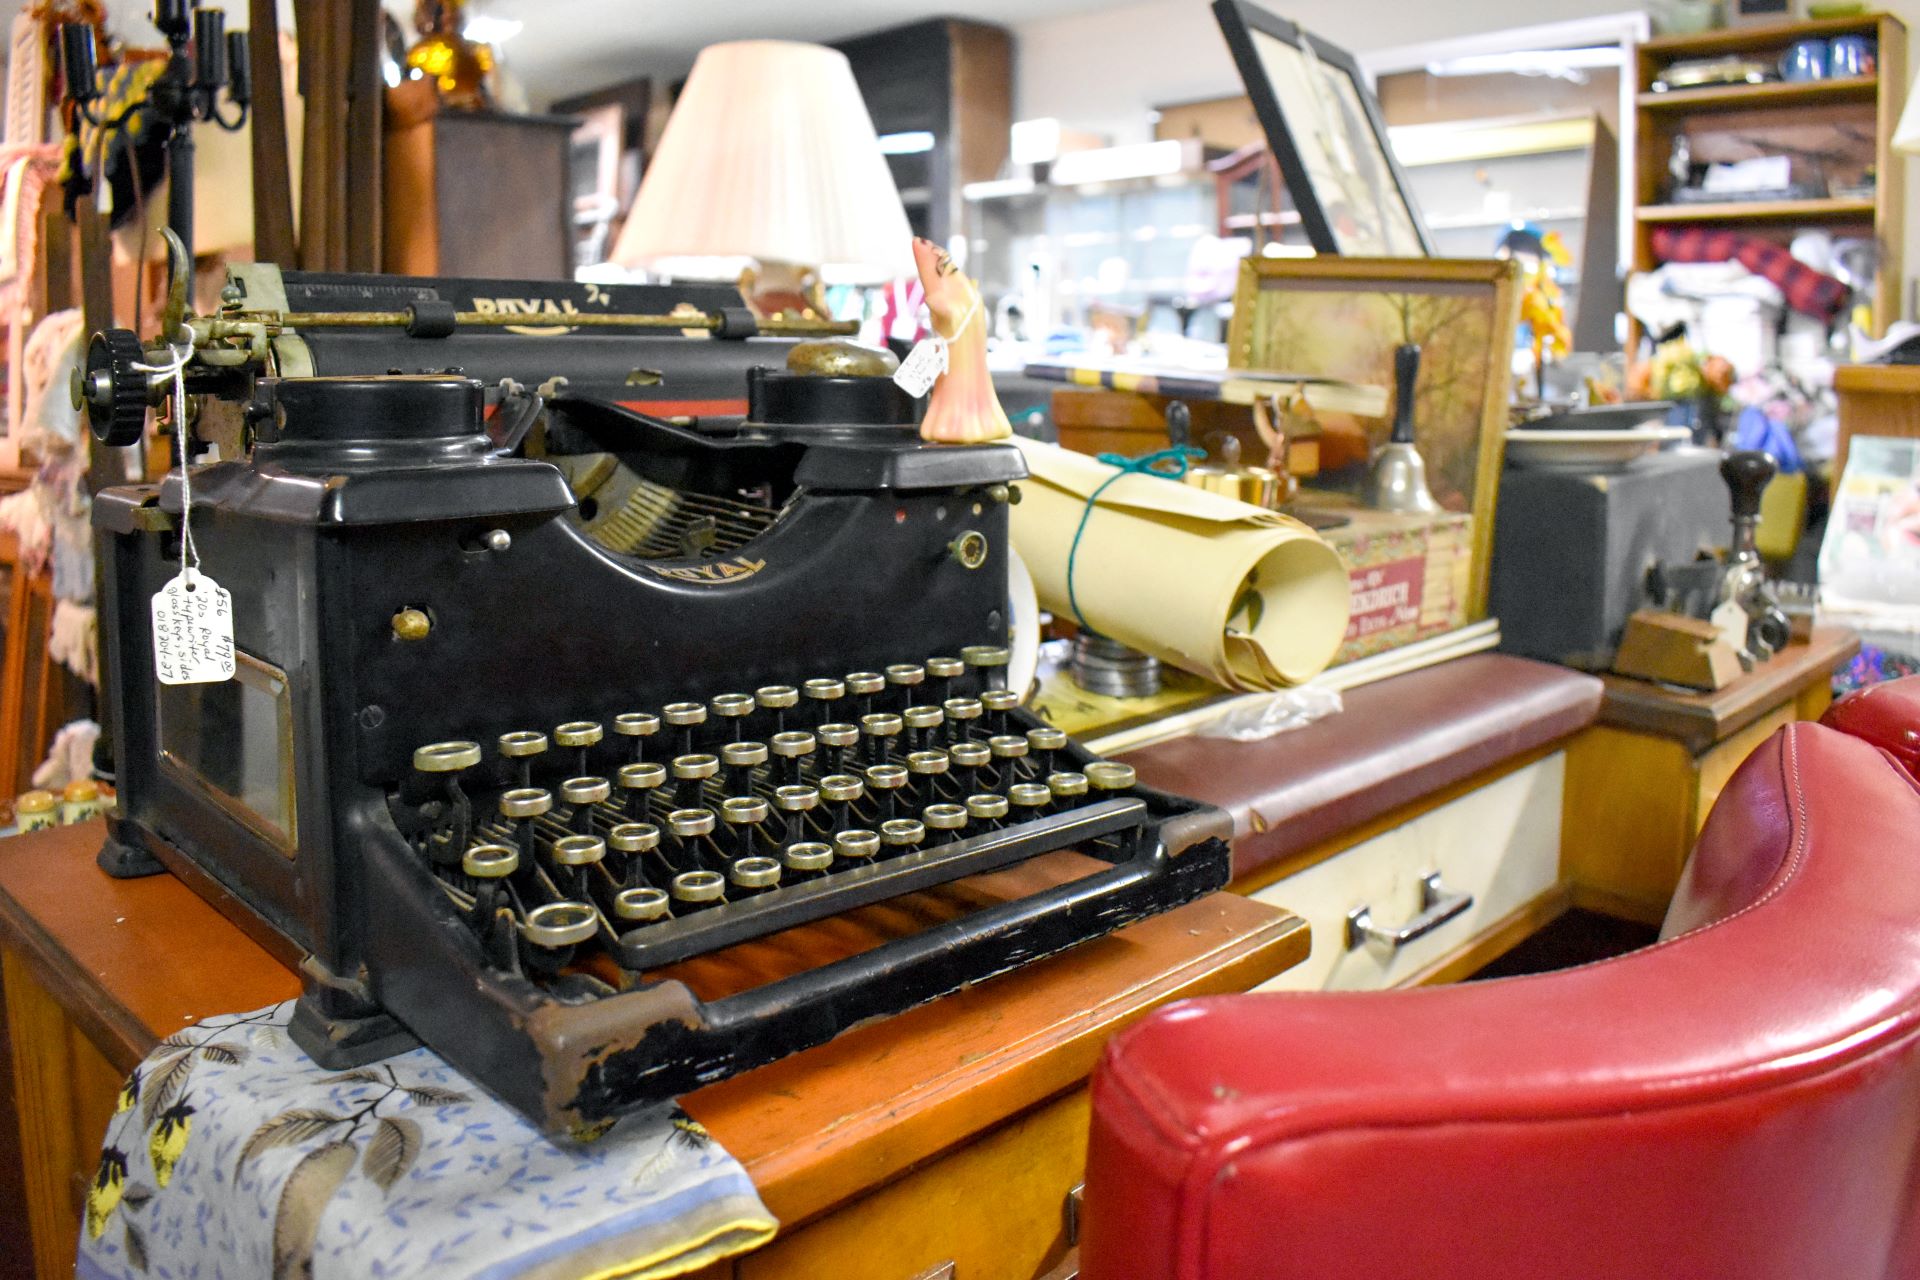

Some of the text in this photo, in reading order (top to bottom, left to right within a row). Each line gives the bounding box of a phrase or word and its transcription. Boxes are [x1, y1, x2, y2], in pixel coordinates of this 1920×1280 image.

[645, 556, 767, 581] ROYAL
[167, 586, 180, 616] glass
[178, 651, 193, 681] sides
[181, 596, 201, 664] typewriter
[197, 627, 216, 661] Royal
